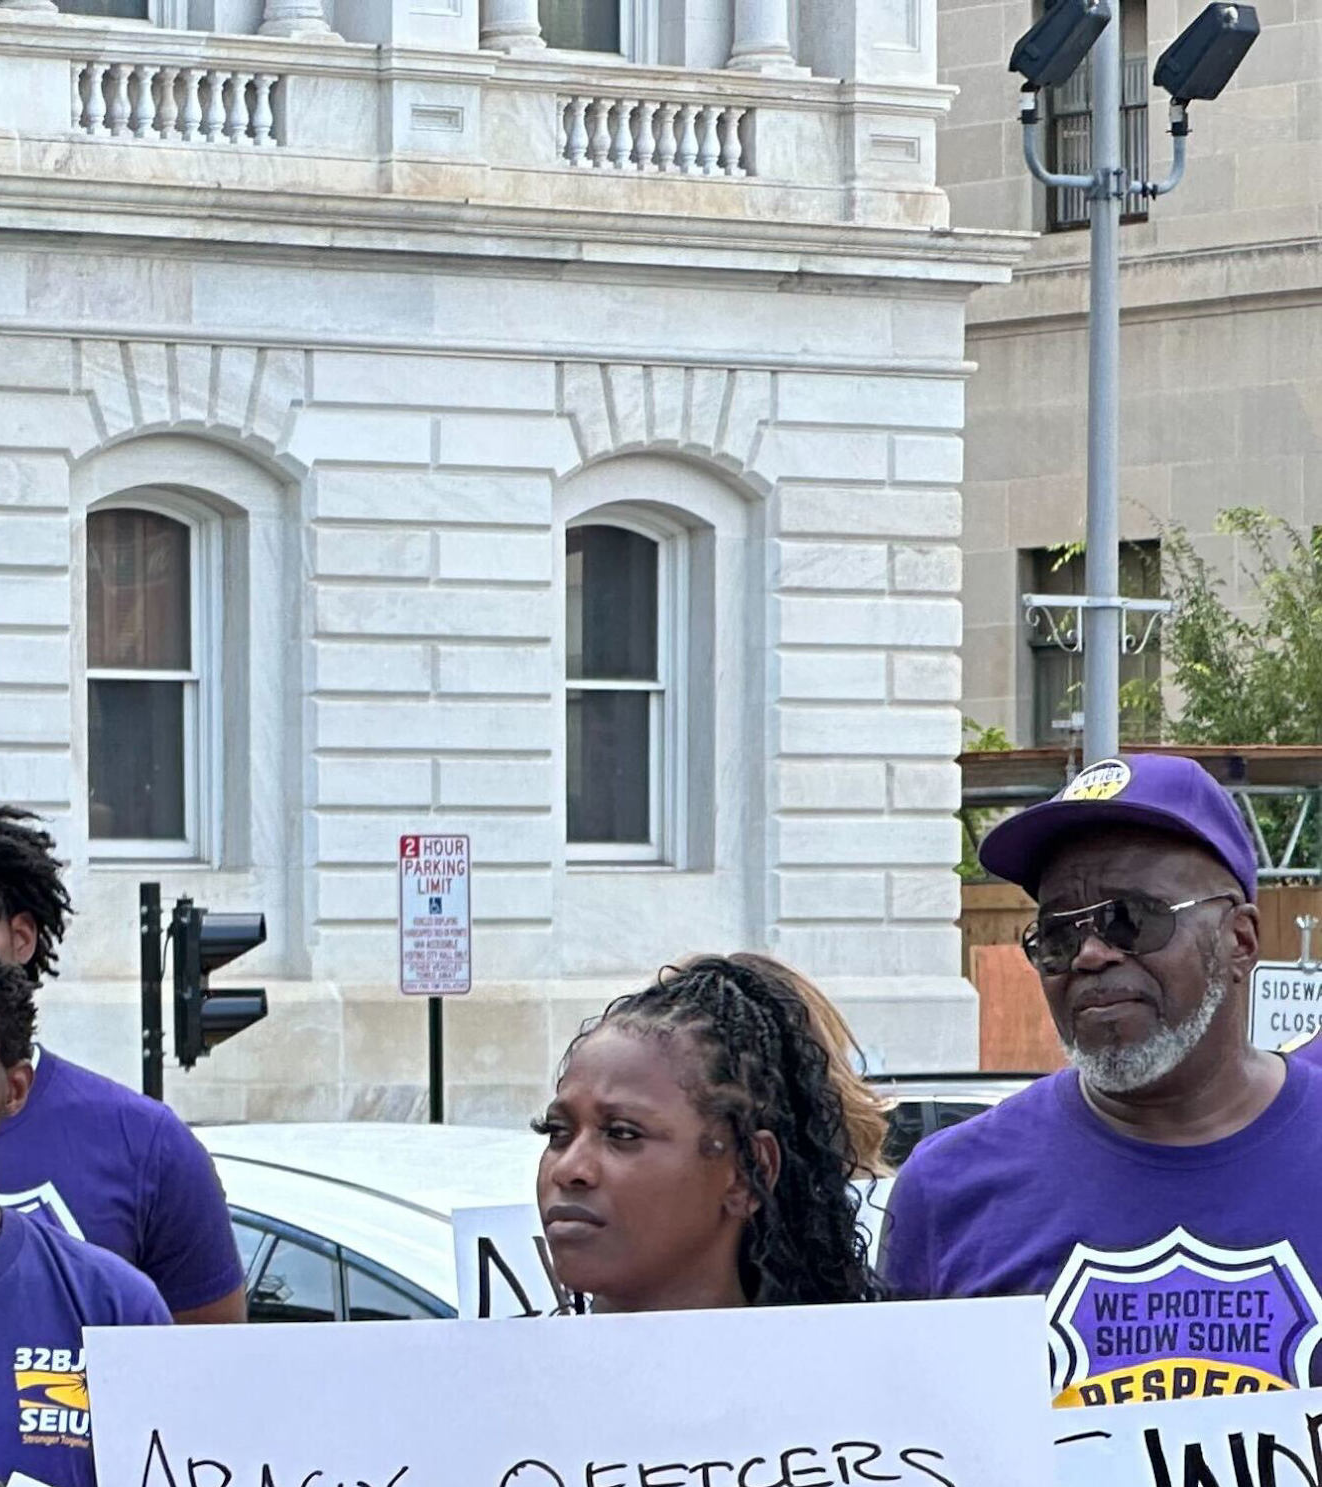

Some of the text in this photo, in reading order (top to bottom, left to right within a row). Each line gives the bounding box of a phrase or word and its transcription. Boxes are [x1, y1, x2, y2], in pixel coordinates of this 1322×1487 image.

[405, 838, 464, 856] 2 HOUR
[404, 859, 466, 876] PARKING
[417, 878, 452, 895] LIMIT
[1094, 1289, 1274, 1321] WE PROTECT,
[1096, 1322, 1270, 1357] SHOW SOME
[14, 1347, 87, 1372] 32BJ
[19, 1408, 90, 1435] SEIU
